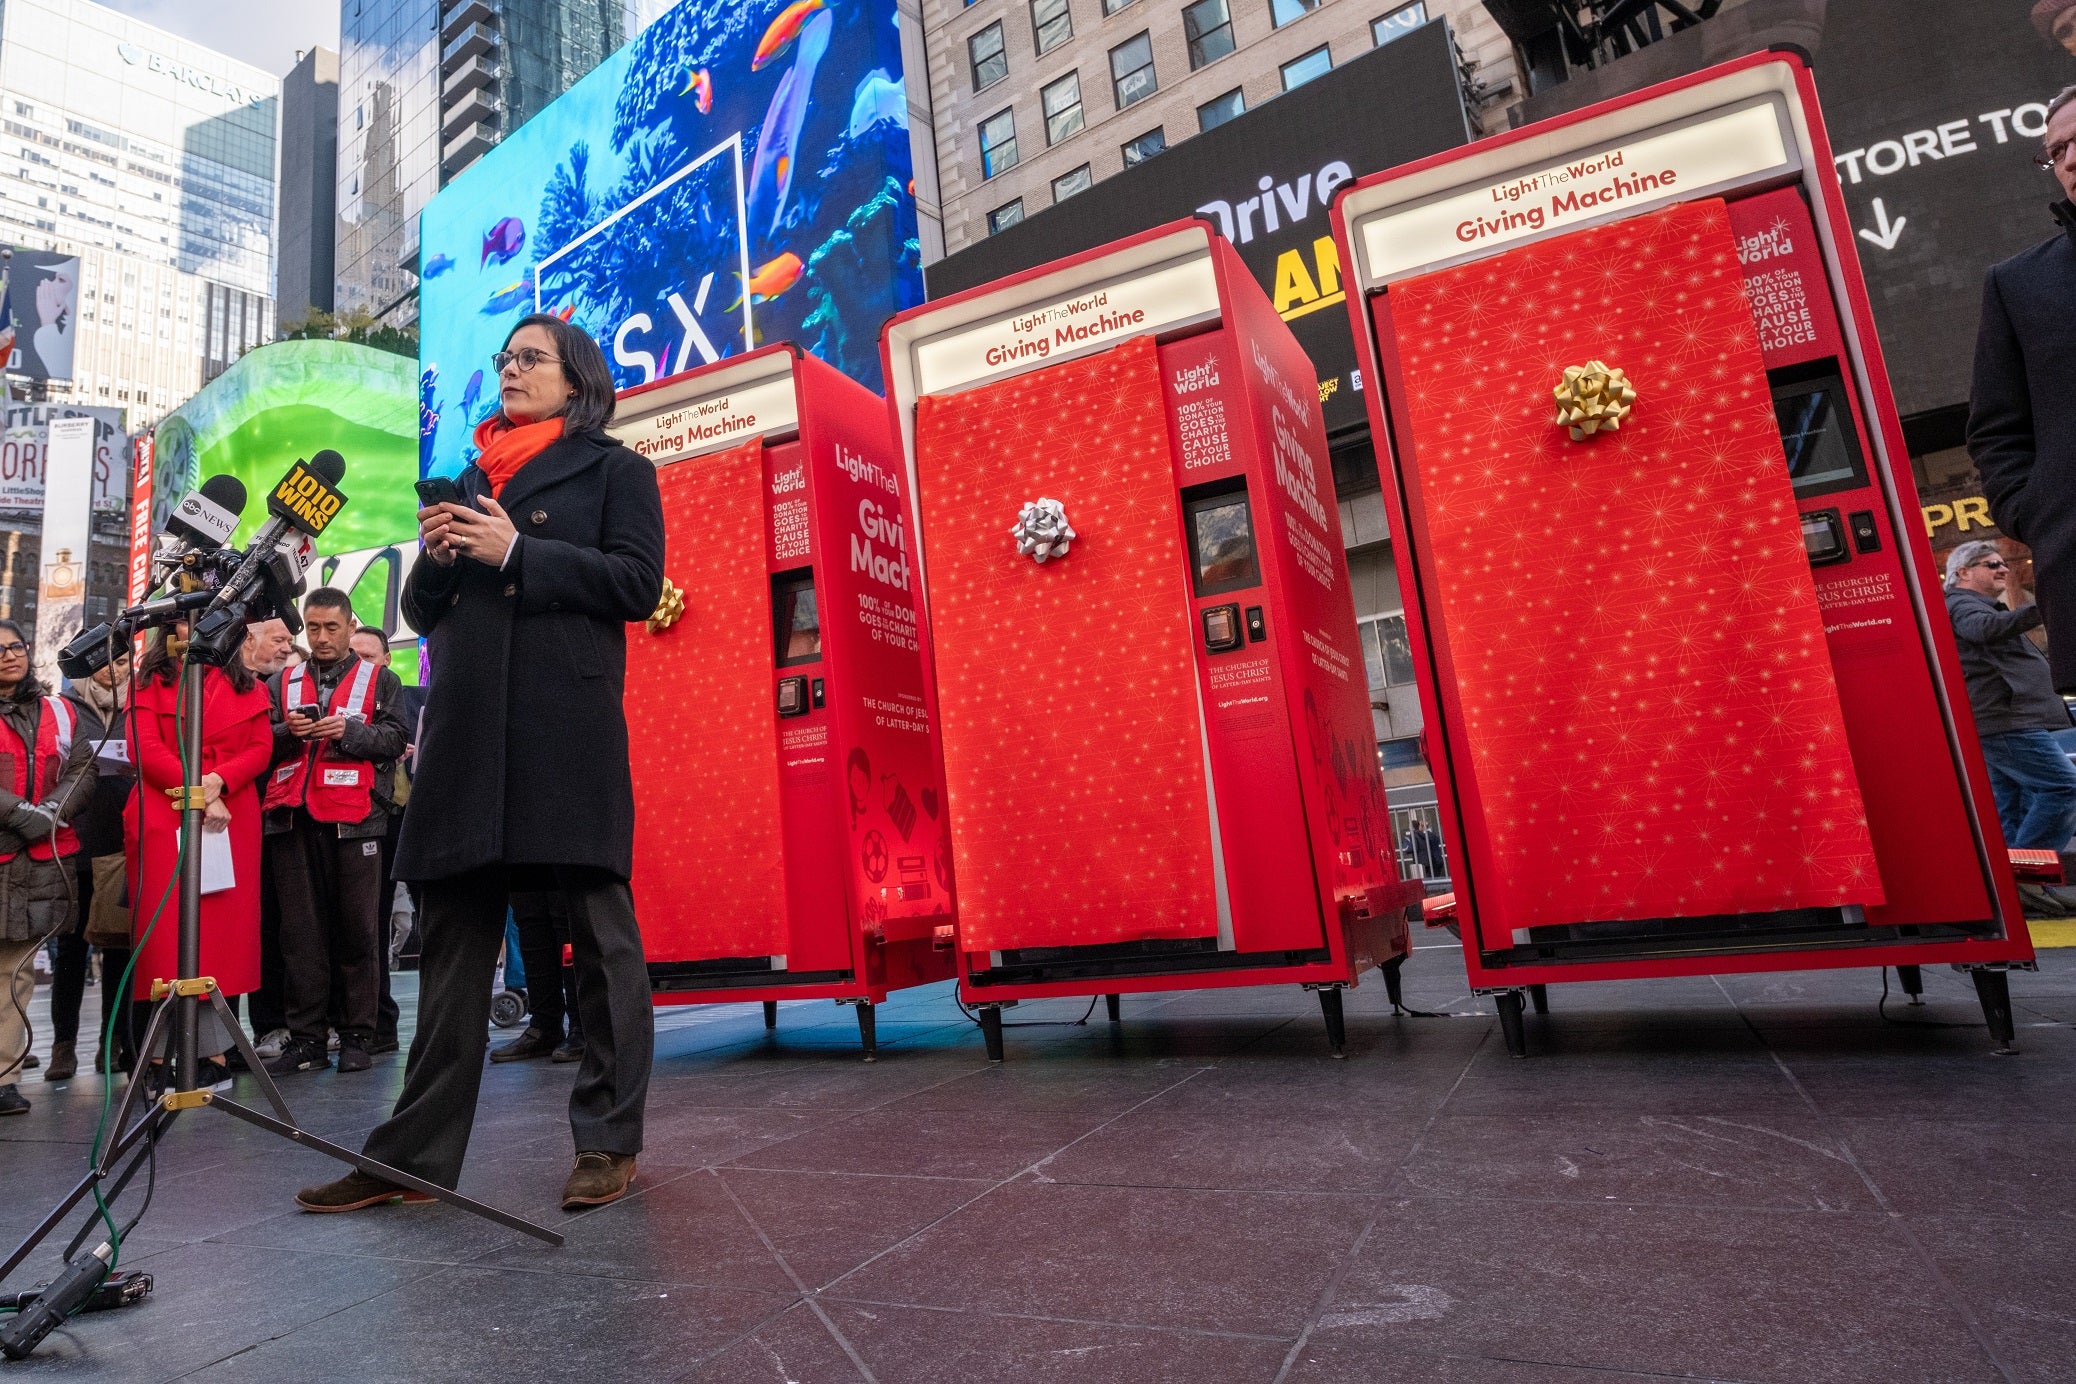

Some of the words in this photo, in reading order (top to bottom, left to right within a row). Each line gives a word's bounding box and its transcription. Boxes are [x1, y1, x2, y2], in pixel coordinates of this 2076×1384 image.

[148, 53, 260, 110] BARCLAYS
[1978, 98, 2056, 144] TO
[1491, 151, 1625, 203] LightTheWorld
[1196, 160, 1353, 245] Drive
[1455, 206, 1545, 243] Giving
[1551, 168, 1678, 217] Machine
[1744, 273, 1774, 290] 00%
[1746, 278, 1802, 297] ONATION
[1749, 290, 1789, 308] OES
[1752, 297, 1806, 318] HARITY
[1013, 291, 1109, 333] LightTheWorld
[1759, 308, 1811, 330] AUSE
[985, 337, 1050, 367] Giving
[1055, 309, 1145, 347] Machine
[1771, 321, 1813, 337] YOUR
[1762, 330, 1817, 351] HOICE
[1176, 364, 1211, 382] Light
[1173, 372, 1220, 395] World
[1318, 377, 1339, 391] JECT
[656, 398, 730, 430] LightTheWorld
[1177, 401, 1205, 416] 100%
[1179, 405, 1225, 423] DONATION
[1180, 416, 1215, 432] GOES
[1181, 422, 1227, 441] CHARITY
[634, 436, 684, 457] Giving
[687, 414, 757, 444] Machine
[1182, 432, 1229, 451] CAUSE
[1184, 450, 1198, 461] OF
[1200, 443, 1230, 456] YOUR
[1272, 404, 1317, 496] Giving
[835, 443, 900, 497] LightThe
[1185, 451, 1232, 470] CHOICE
[772, 477, 806, 495] World
[774, 470, 800, 484] Light
[288, 465, 341, 516] 1010
[1272, 441, 1328, 533] Machine
[276, 481, 329, 531] WINS
[773, 506, 808, 519] DONATION
[134, 498, 150, 551] FREE
[183, 501, 201, 512] abc
[200, 510, 233, 534] NEWS
[774, 515, 800, 527] GOES
[774, 521, 809, 535] CHARITY
[774, 529, 810, 544] CAUSE
[775, 545, 811, 560] CHOICE
[787, 539, 810, 549] YOUR
[131, 554, 148, 608] CHO
[1826, 576, 1873, 590] CHURCH
[1875, 573, 1890, 582] OF
[1817, 592, 1841, 602] SUS
[1842, 582, 1892, 599] CHRIST
[1820, 598, 1867, 610] LATTER-DAY
[1867, 593, 1895, 602] SAINTS
[859, 611, 881, 628] GOES
[1824, 617, 1892, 634] ightTheWorld.org
[871, 628, 882, 641] OF
[884, 631, 906, 648] YOUR
[907, 638, 920, 652] CH
[1209, 666, 1225, 675] THE
[1225, 660, 1259, 672] CHURCH
[1258, 658, 1270, 666] OF
[1210, 672, 1235, 684] JESUS
[1235, 666, 1270, 680] CHRIST
[863, 696, 877, 710] THE
[877, 700, 905, 715] CHURCH
[905, 706, 915, 716] OF
[794, 727, 819, 736] CHURCH
[875, 715, 885, 726] OF
[886, 717, 925, 732] LATTER-DAY
[801, 731, 828, 743] CHRIST
